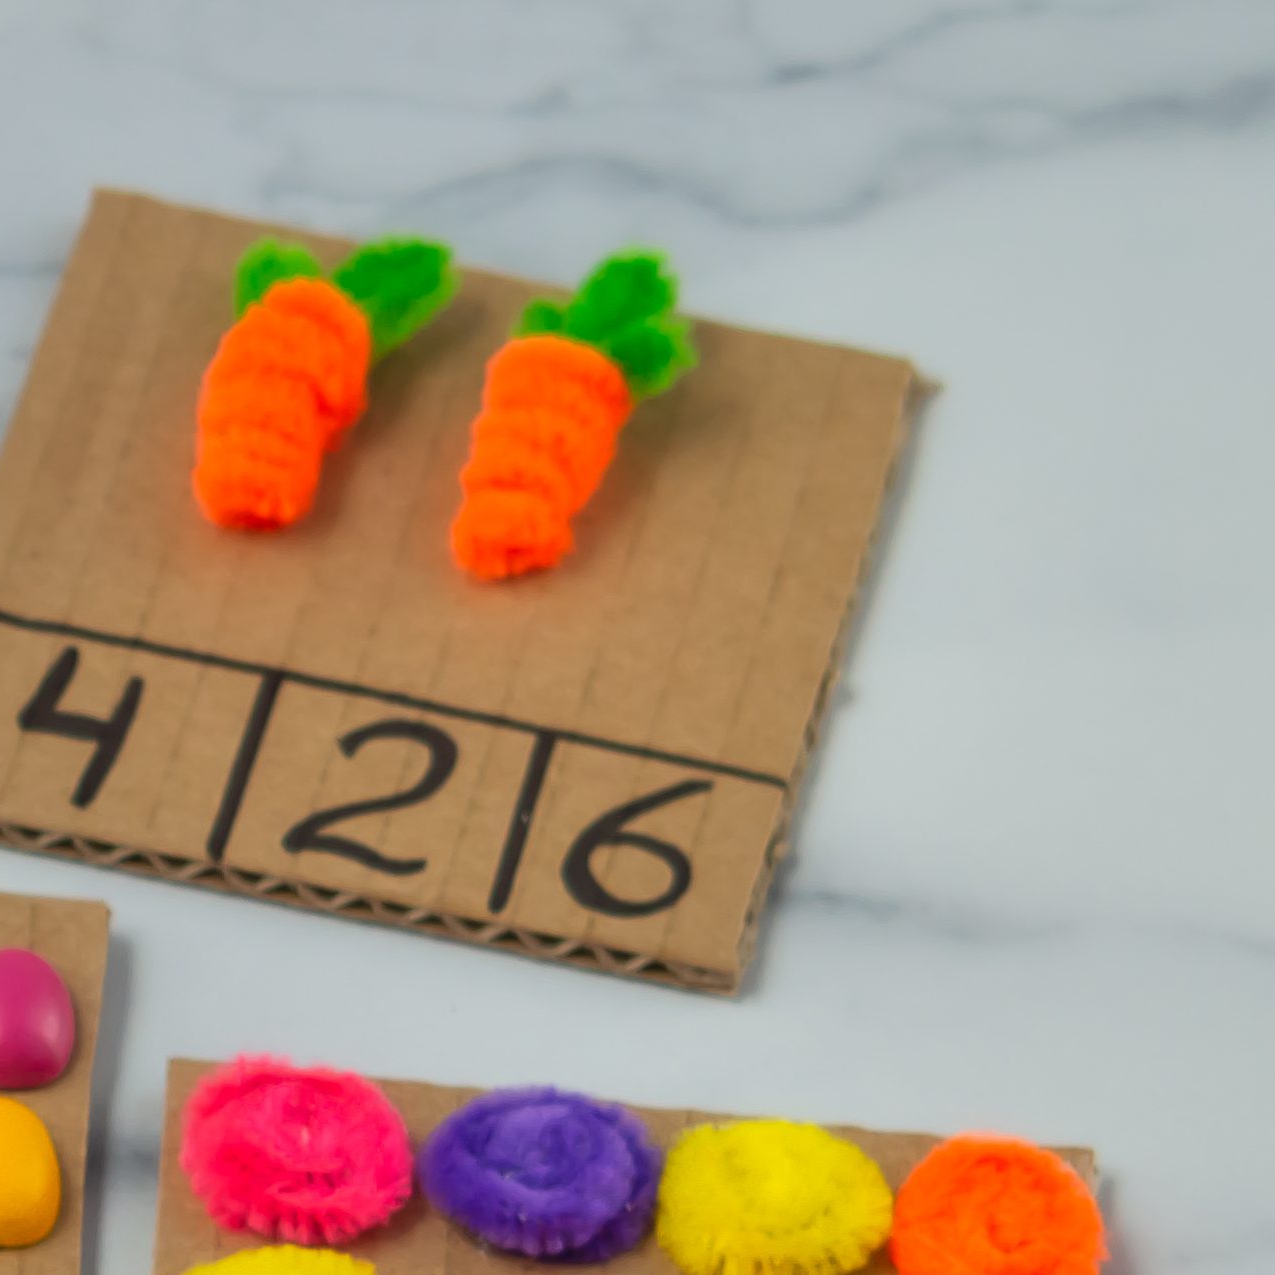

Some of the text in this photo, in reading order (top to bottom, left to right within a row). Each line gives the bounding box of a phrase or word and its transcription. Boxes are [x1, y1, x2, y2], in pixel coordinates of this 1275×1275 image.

[17, 645, 714, 918] 4 2 6
